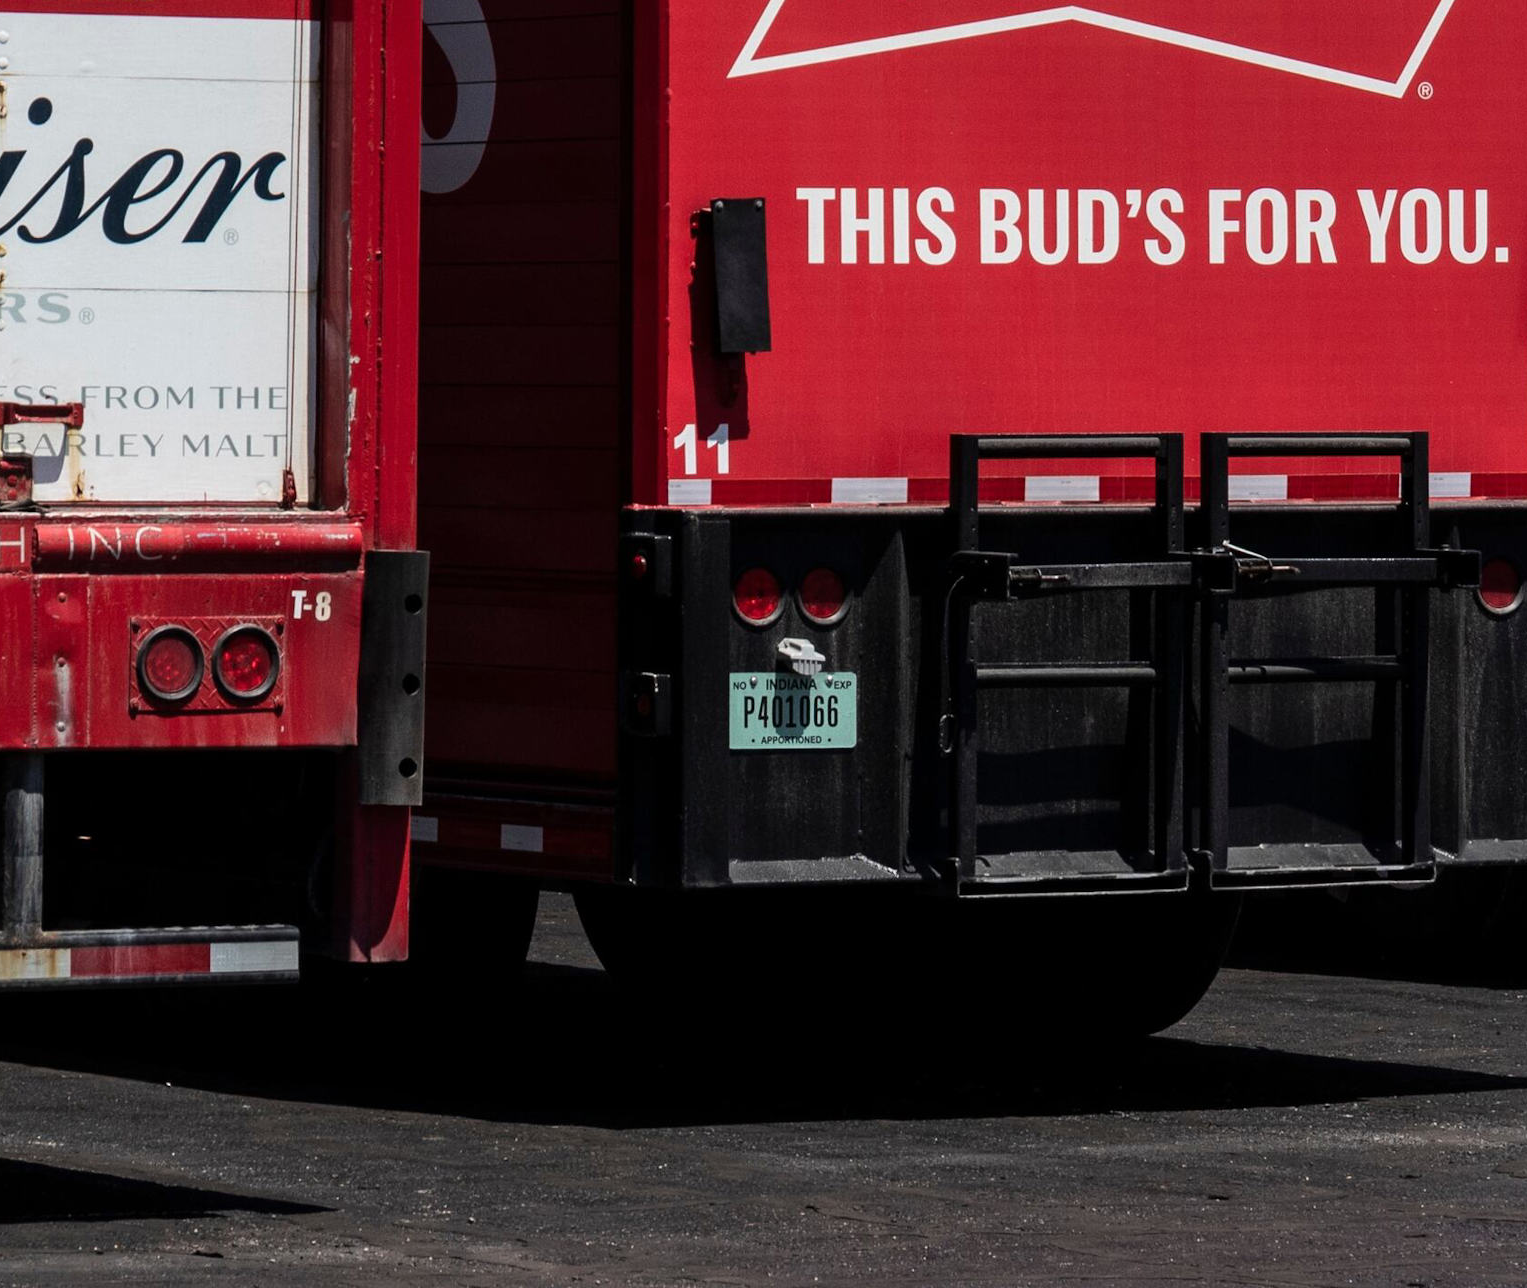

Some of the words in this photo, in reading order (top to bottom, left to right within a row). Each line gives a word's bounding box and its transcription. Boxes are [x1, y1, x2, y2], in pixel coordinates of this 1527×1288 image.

[796, 186, 956, 265] THIS
[979, 187, 1185, 265] BUD'S
[1208, 188, 1337, 264] FOR
[1357, 188, 1510, 264] YOU.
[81, 386, 195, 410] FROM
[210, 386, 288, 411] THE
[182, 433, 288, 458] MALT
[674, 423, 730, 475] 11
[291, 589, 332, 622] T-8
[733, 681, 747, 690] NO
[766, 678, 817, 691] INDIANA
[834, 680, 852, 690] EXP
[744, 695, 838, 728] P401066
[761, 735, 822, 745] APPORTIONED
